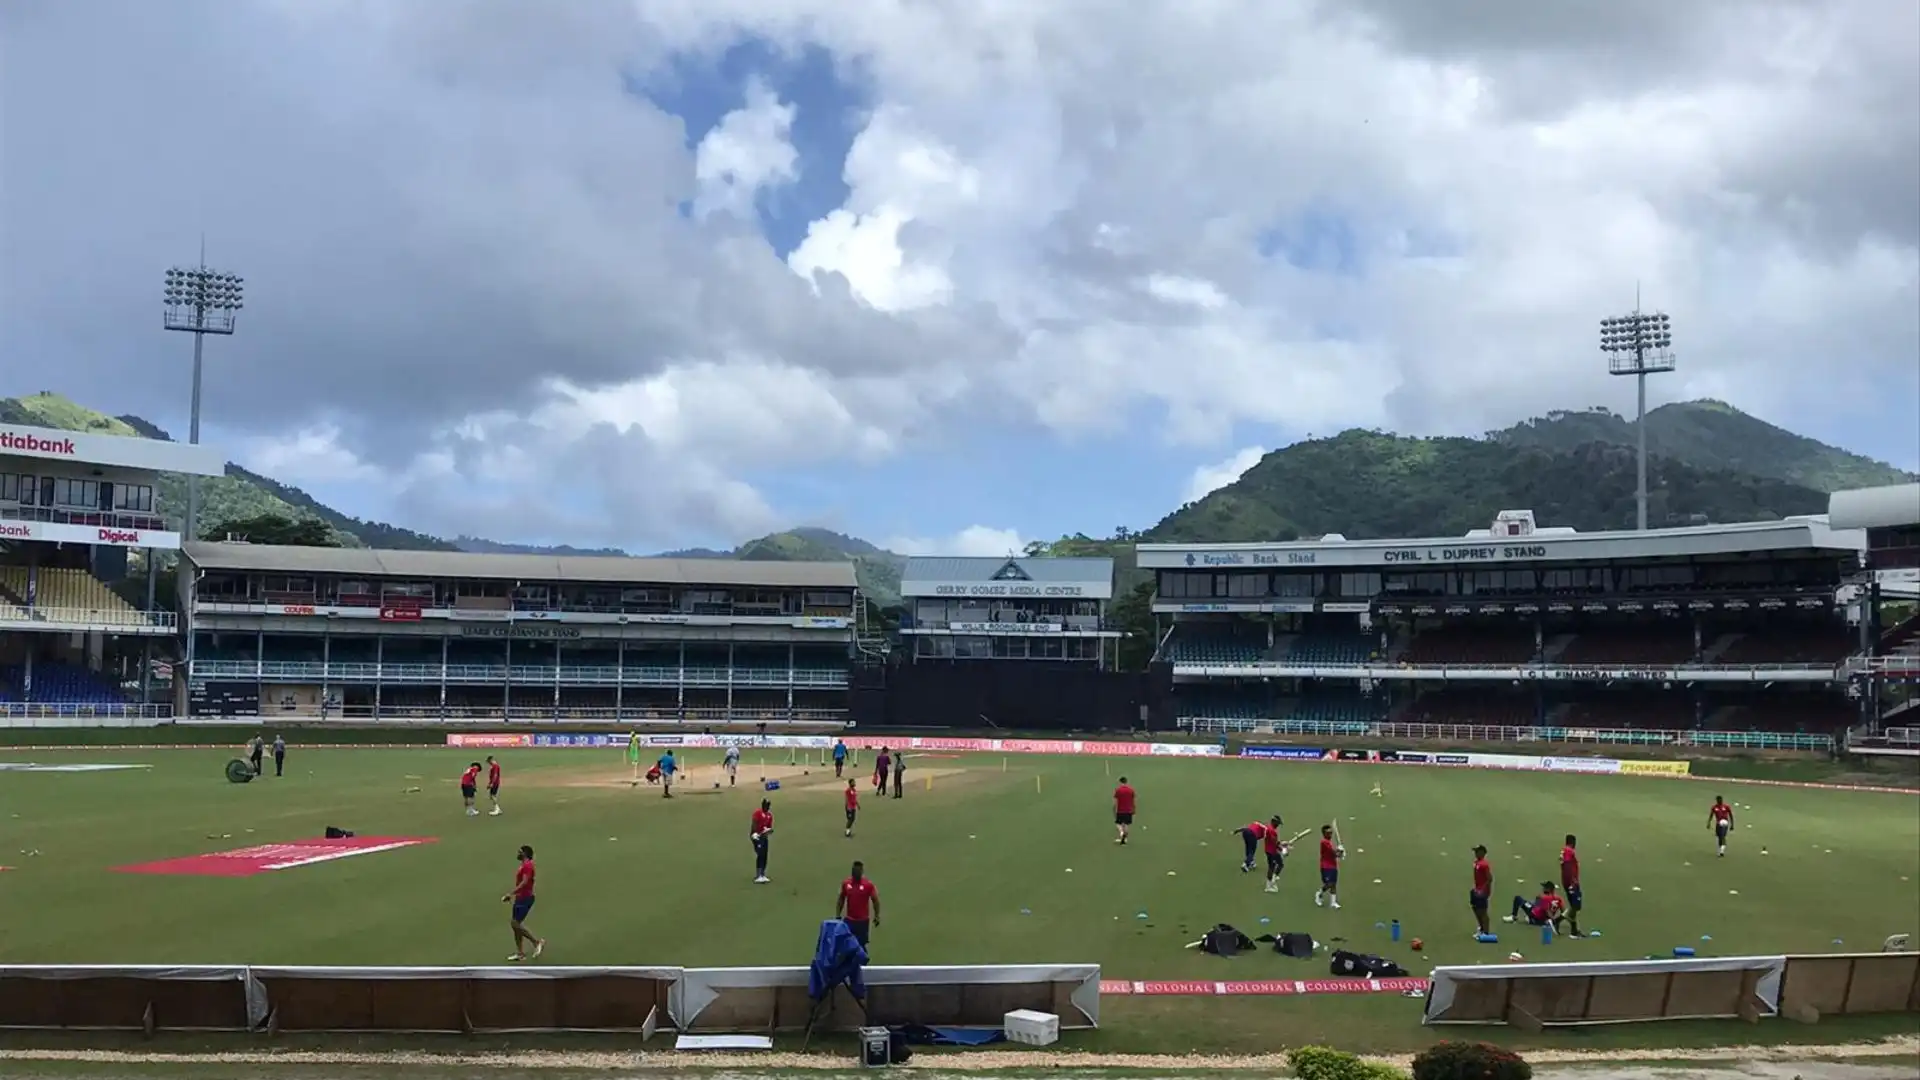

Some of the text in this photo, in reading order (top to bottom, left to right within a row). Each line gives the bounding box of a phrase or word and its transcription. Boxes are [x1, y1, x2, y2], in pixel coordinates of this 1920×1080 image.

[0, 432, 75, 454] tiabank
[98, 529, 139, 544] Digicel
[1203, 552, 1316, 566] Republic Bank Stand
[1384, 546, 1546, 562] CYRIL L DUPREY STAND
[936, 585, 1083, 596] GERRY GOMEZ MEDIA CENTRE
[1034, 624, 1050, 632] END
[1555, 670, 1614, 679] FINANCIAL
[1620, 670, 1667, 680] LIMITED
[921, 739, 991, 749] COLONIAL
[1002, 740, 1072, 751] COLONIAL
[1084, 743, 1148, 754] COLONIAL
[1145, 983, 1210, 993] COLONIAL
[1226, 983, 1292, 993] COLONIAL
[1306, 982, 1369, 991] COLONIAL
